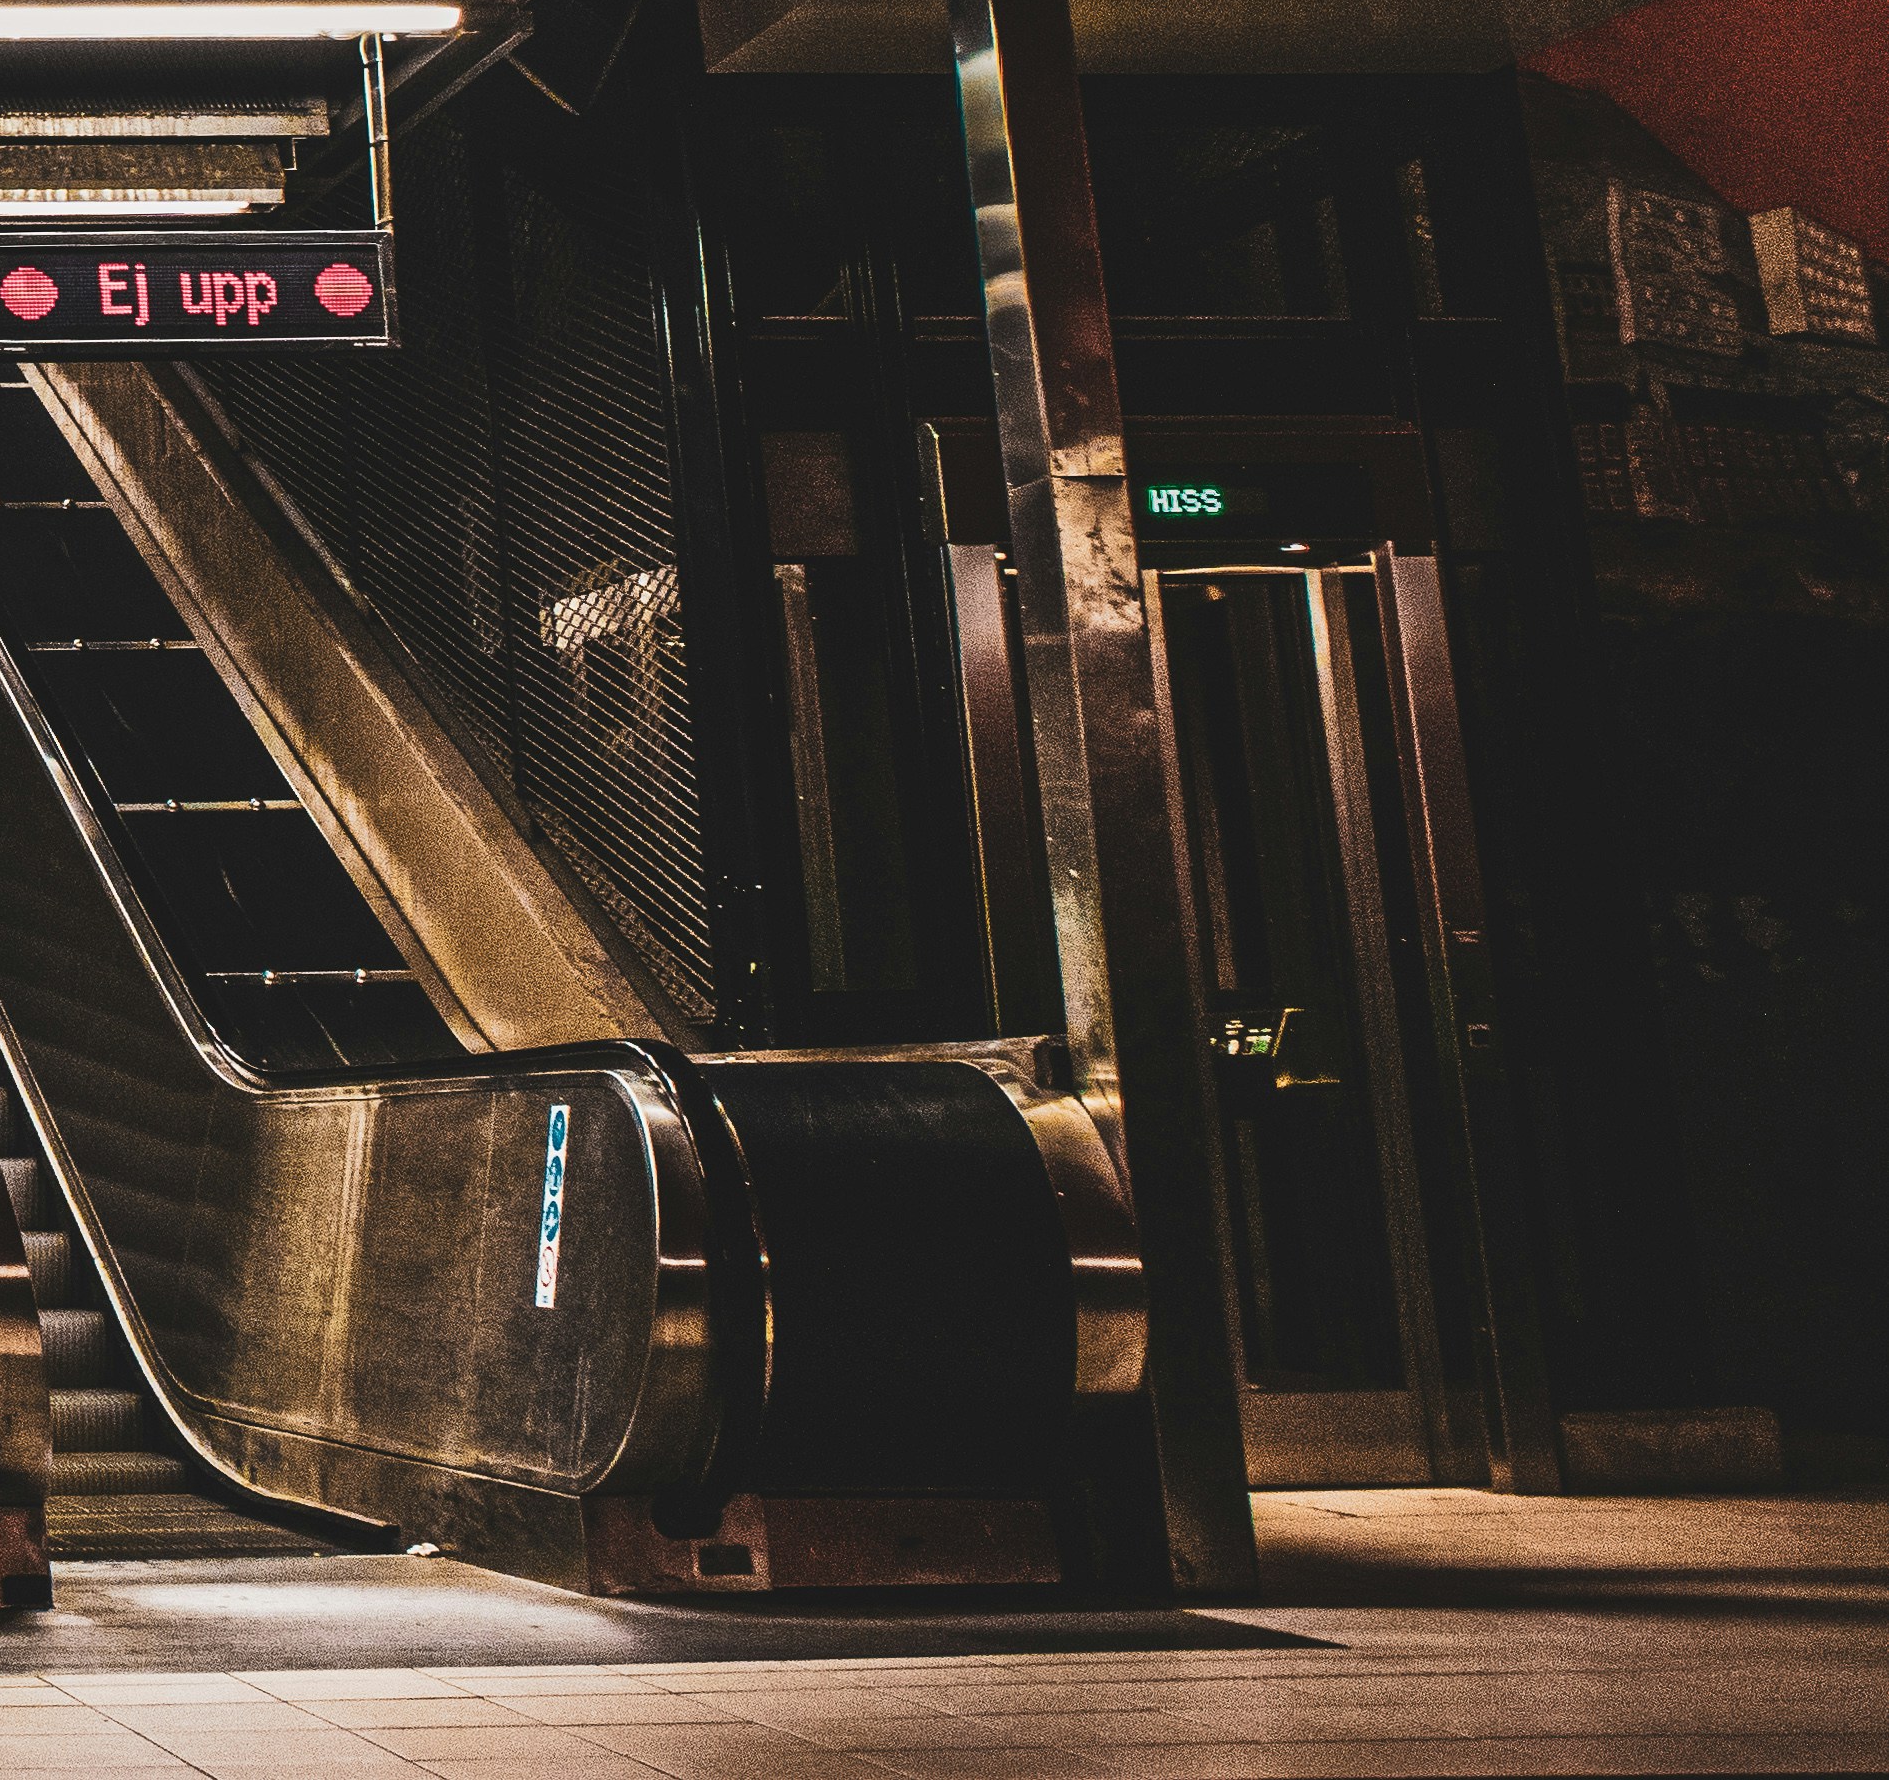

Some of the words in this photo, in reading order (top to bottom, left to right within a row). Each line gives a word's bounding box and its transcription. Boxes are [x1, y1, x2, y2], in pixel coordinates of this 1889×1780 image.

[97, 263, 150, 327] Ej
[179, 271, 279, 327] upp
[1149, 488, 1222, 513] HISS
